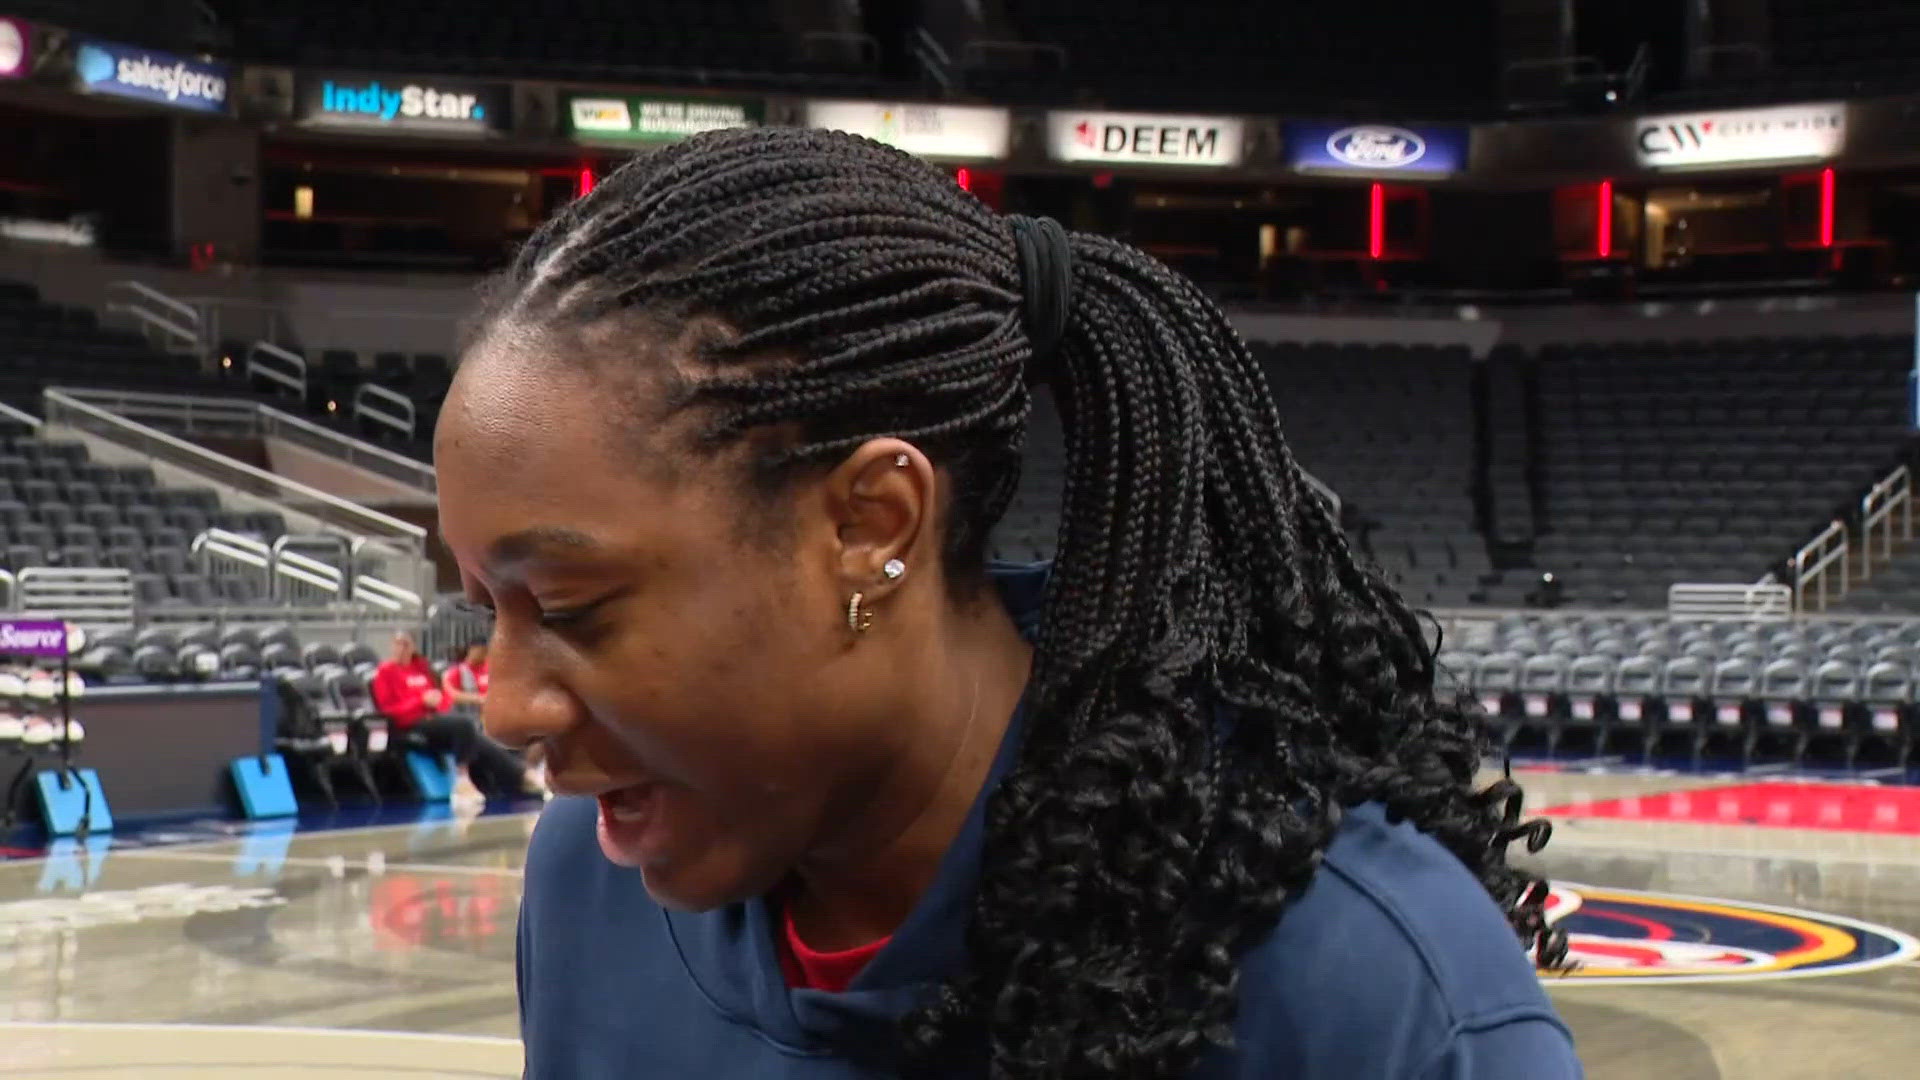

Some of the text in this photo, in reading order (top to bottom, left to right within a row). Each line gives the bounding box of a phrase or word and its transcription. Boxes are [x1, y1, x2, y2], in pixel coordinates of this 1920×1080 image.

[117, 56, 227, 101] salesforce
[1103, 124, 1219, 156] DEEM
[1344, 130, 1408, 162] Ford
